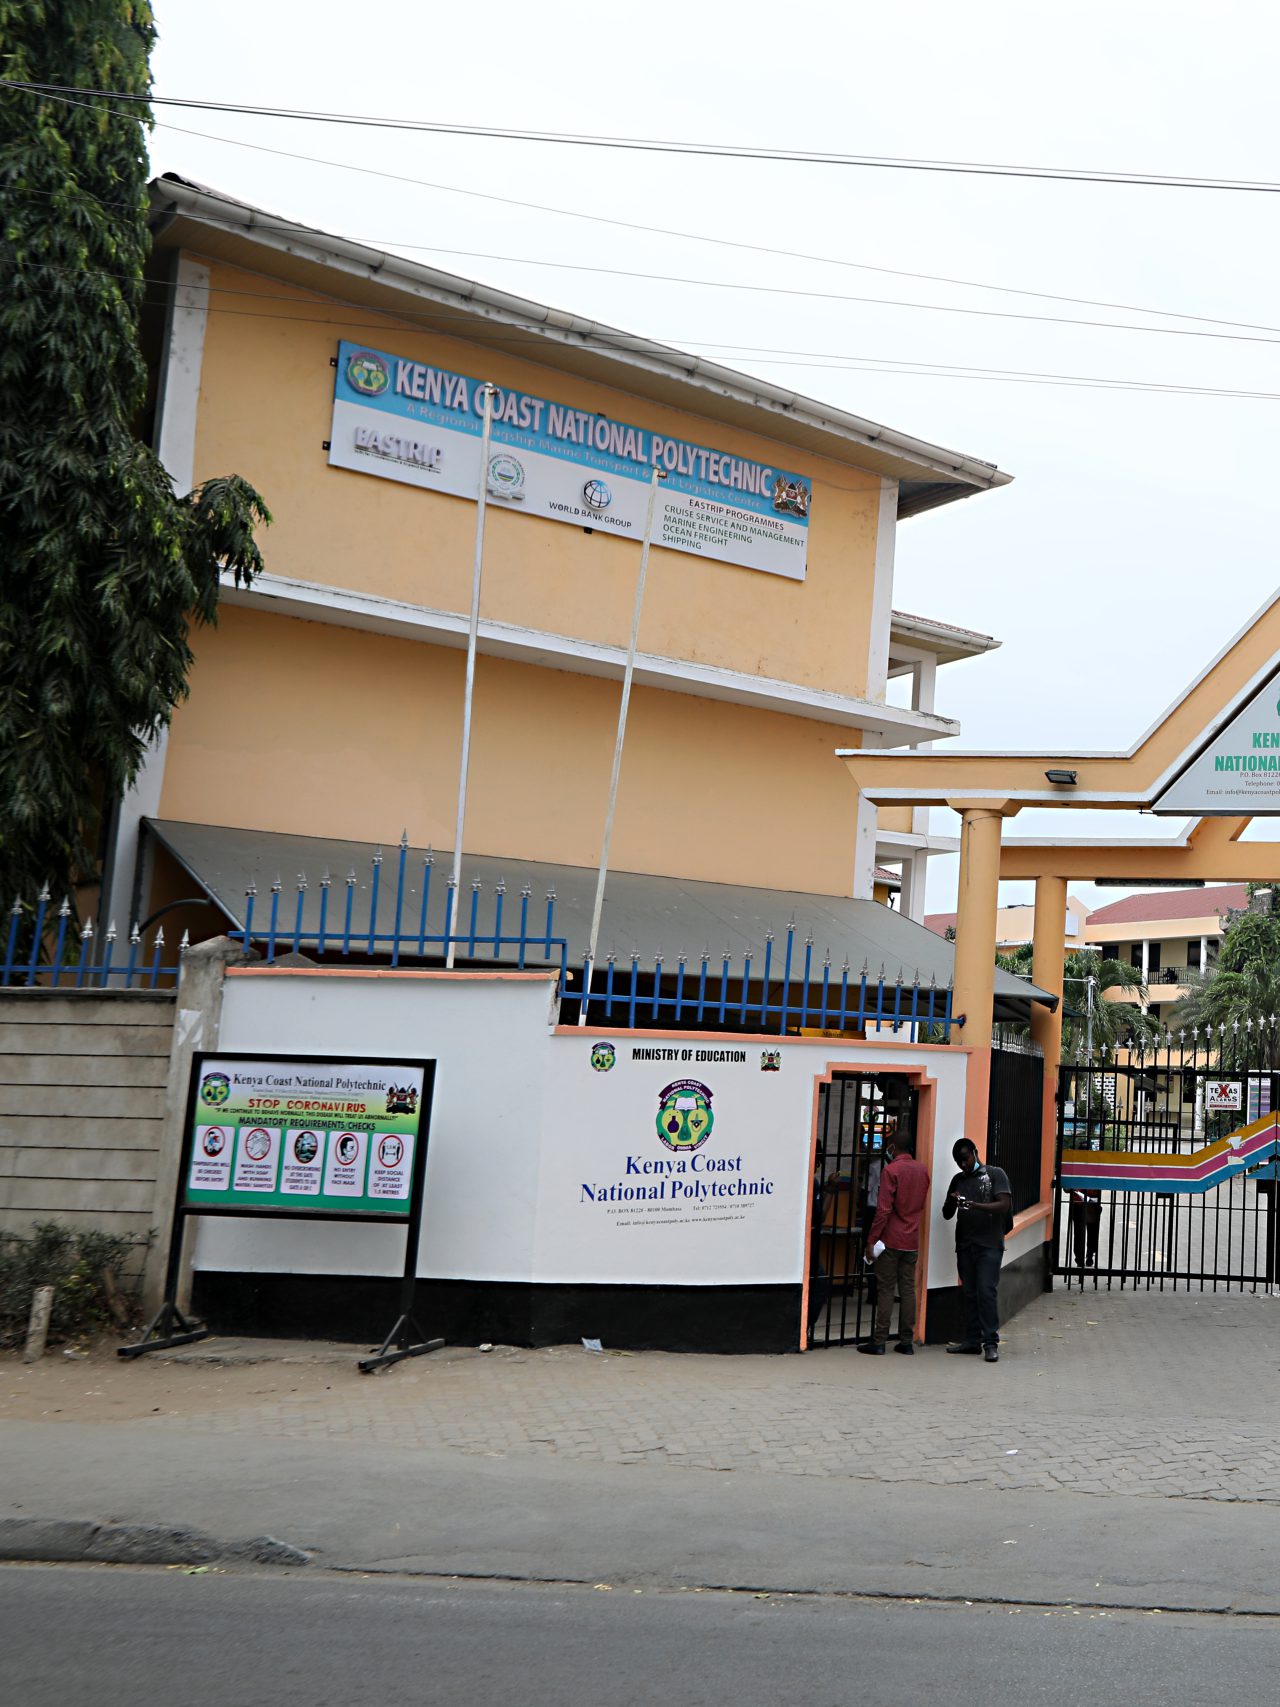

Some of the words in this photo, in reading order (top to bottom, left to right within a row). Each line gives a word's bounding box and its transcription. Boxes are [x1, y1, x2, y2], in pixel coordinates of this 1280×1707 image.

[396, 360, 470, 412] KENYA
[474, 383, 545, 432] COAST
[548, 405, 648, 463] NATIONAL
[651, 435, 773, 497] POLYTECHNIC
[354, 427, 444, 466] EASTRIP
[420, 407, 480, 432] Regional
[540, 439, 581, 460] Marine
[585, 451, 640, 477] Transport
[680, 476, 726, 499] Logistics
[549, 502, 580, 516] WORLD
[581, 509, 603, 523] BANK
[604, 516, 632, 529] GROUP
[664, 504, 694, 519] CRUISE
[696, 512, 730, 528] SERVICE
[730, 520, 748, 533] AND
[750, 526, 805, 548] MANAGEMENT
[689, 498, 725, 514] EASTRIP
[726, 508, 785, 531] PROGRAMMES
[662, 533, 702, 550] SHIPPING
[663, 514, 700, 530] MARINE
[698, 523, 753, 544] ENGINEERING
[663, 523, 693, 538] OCEAN
[694, 532, 729, 547] FREIGHT
[632, 1048, 679, 1062] MINISTRY
[681, 1048, 693, 1062] OF
[695, 1050, 746, 1063] EDUCATION
[233, 1073, 263, 1088] Kenya
[265, 1074, 292, 1087] Coast
[294, 1076, 334, 1089] National
[335, 1078, 387, 1092] Polytechnic
[1209, 1083, 1238, 1099] TEXAS
[248, 1098, 281, 1109] STOP
[286, 1100, 367, 1113] CORONAVIRUS
[1209, 1095, 1238, 1103] ALARMS
[238, 1116, 288, 1126] MANDATORY
[625, 1155, 686, 1179] Kenya
[690, 1153, 742, 1173] Coast
[580, 1181, 665, 1203] National
[670, 1177, 774, 1203] Polytechnic
